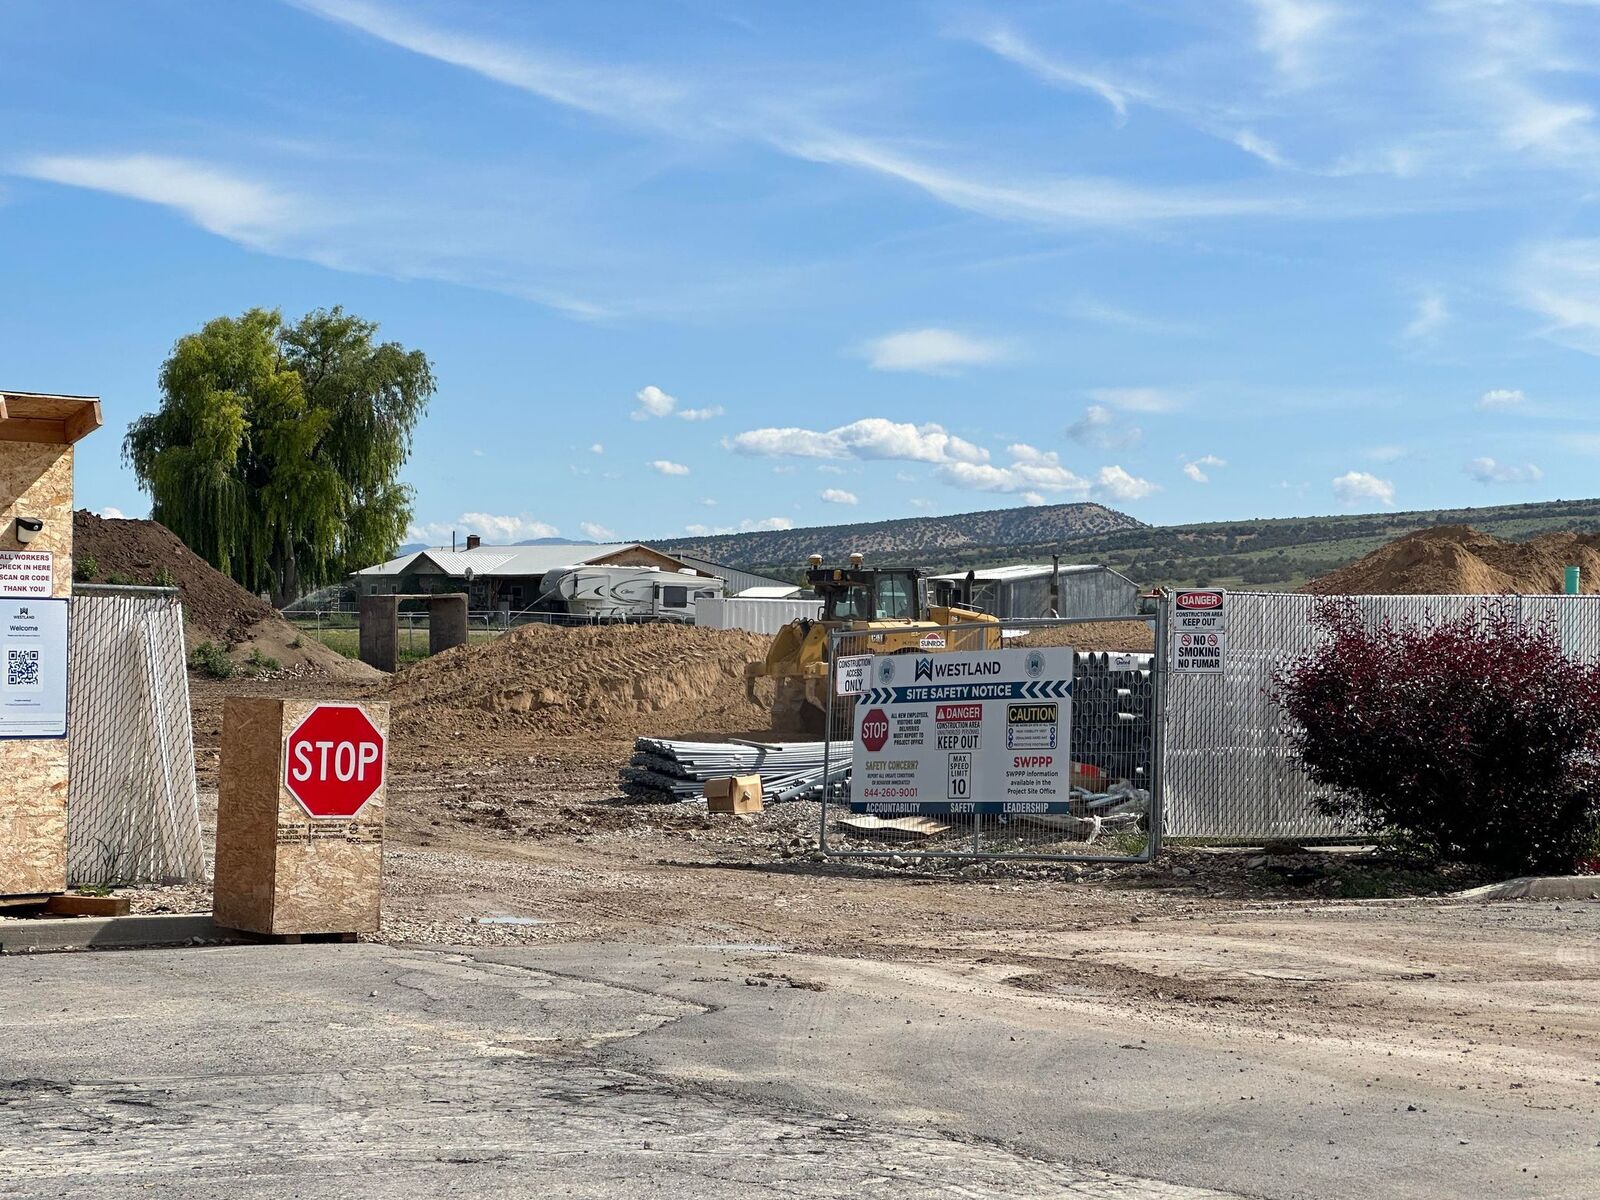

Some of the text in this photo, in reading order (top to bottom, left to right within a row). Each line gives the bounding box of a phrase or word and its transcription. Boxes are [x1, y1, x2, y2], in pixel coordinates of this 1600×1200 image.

[1182, 596, 1218, 604] DANGER
[1182, 618, 1216, 626] KEEP OUT
[1194, 635, 1206, 646] NO
[1178, 647, 1220, 657] SMOKING
[838, 659, 871, 668] CONSTRUCTION
[1178, 659, 1220, 668] NO FUMAR
[846, 669, 862, 677] ACCESS
[935, 661, 1001, 677] WESTLAND
[845, 679, 863, 692] ONLY
[906, 685, 1012, 700] SITE SAFETY NOTICE
[946, 707, 980, 718] DANGER
[1010, 707, 1056, 721] CAUTION
[863, 722, 888, 739] STOP
[938, 735, 978, 749] KEEP OUT
[292, 740, 379, 782] STOP
[865, 760, 918, 770] SAFETY CONCERN?
[1014, 756, 1052, 767] SWPPP
[952, 779, 966, 794] 10
[864, 788, 918, 797] 844-260-9001
[866, 803, 920, 812] ACCOUNTABILITY
[950, 803, 975, 813] SAFETY
[1003, 803, 1049, 813] LEADERSHIP
